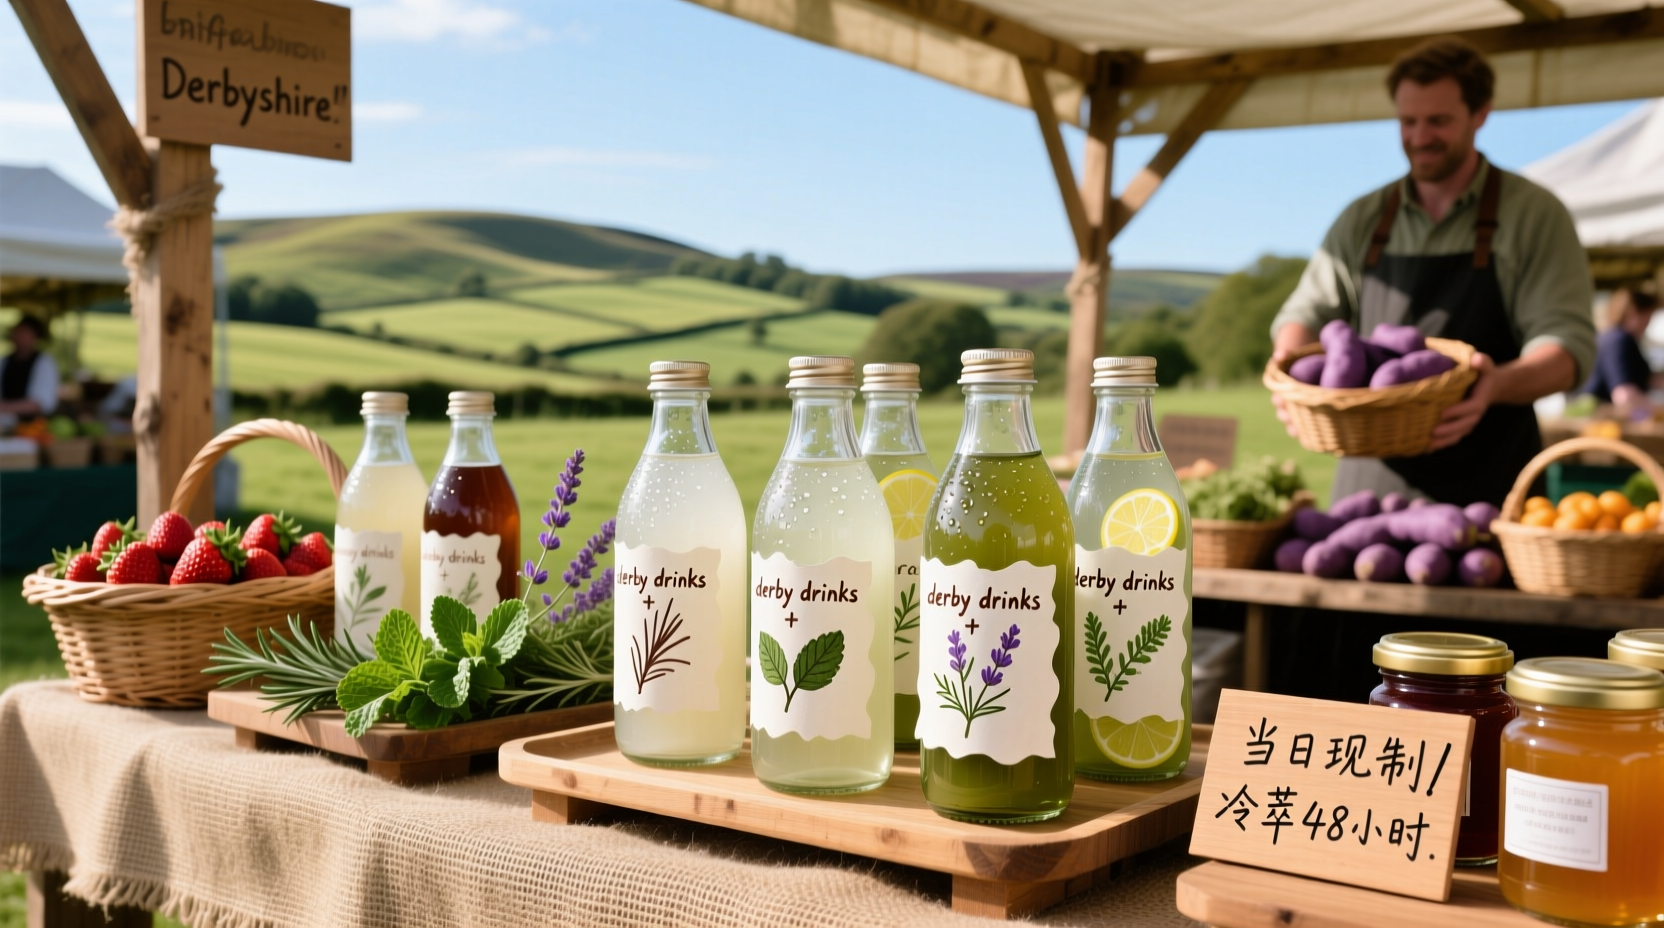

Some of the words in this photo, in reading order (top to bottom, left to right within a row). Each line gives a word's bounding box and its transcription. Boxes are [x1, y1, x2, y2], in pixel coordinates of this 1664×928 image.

[448, 549, 486, 565] drinks
[617, 564, 648, 594] derby
[654, 567, 707, 588] drinks
[756, 576, 794, 609] derby
[800, 580, 858, 603] drinks
[1122, 569, 1175, 591] drinks
[927, 583, 971, 617] derby
[978, 587, 1041, 611] drinks
